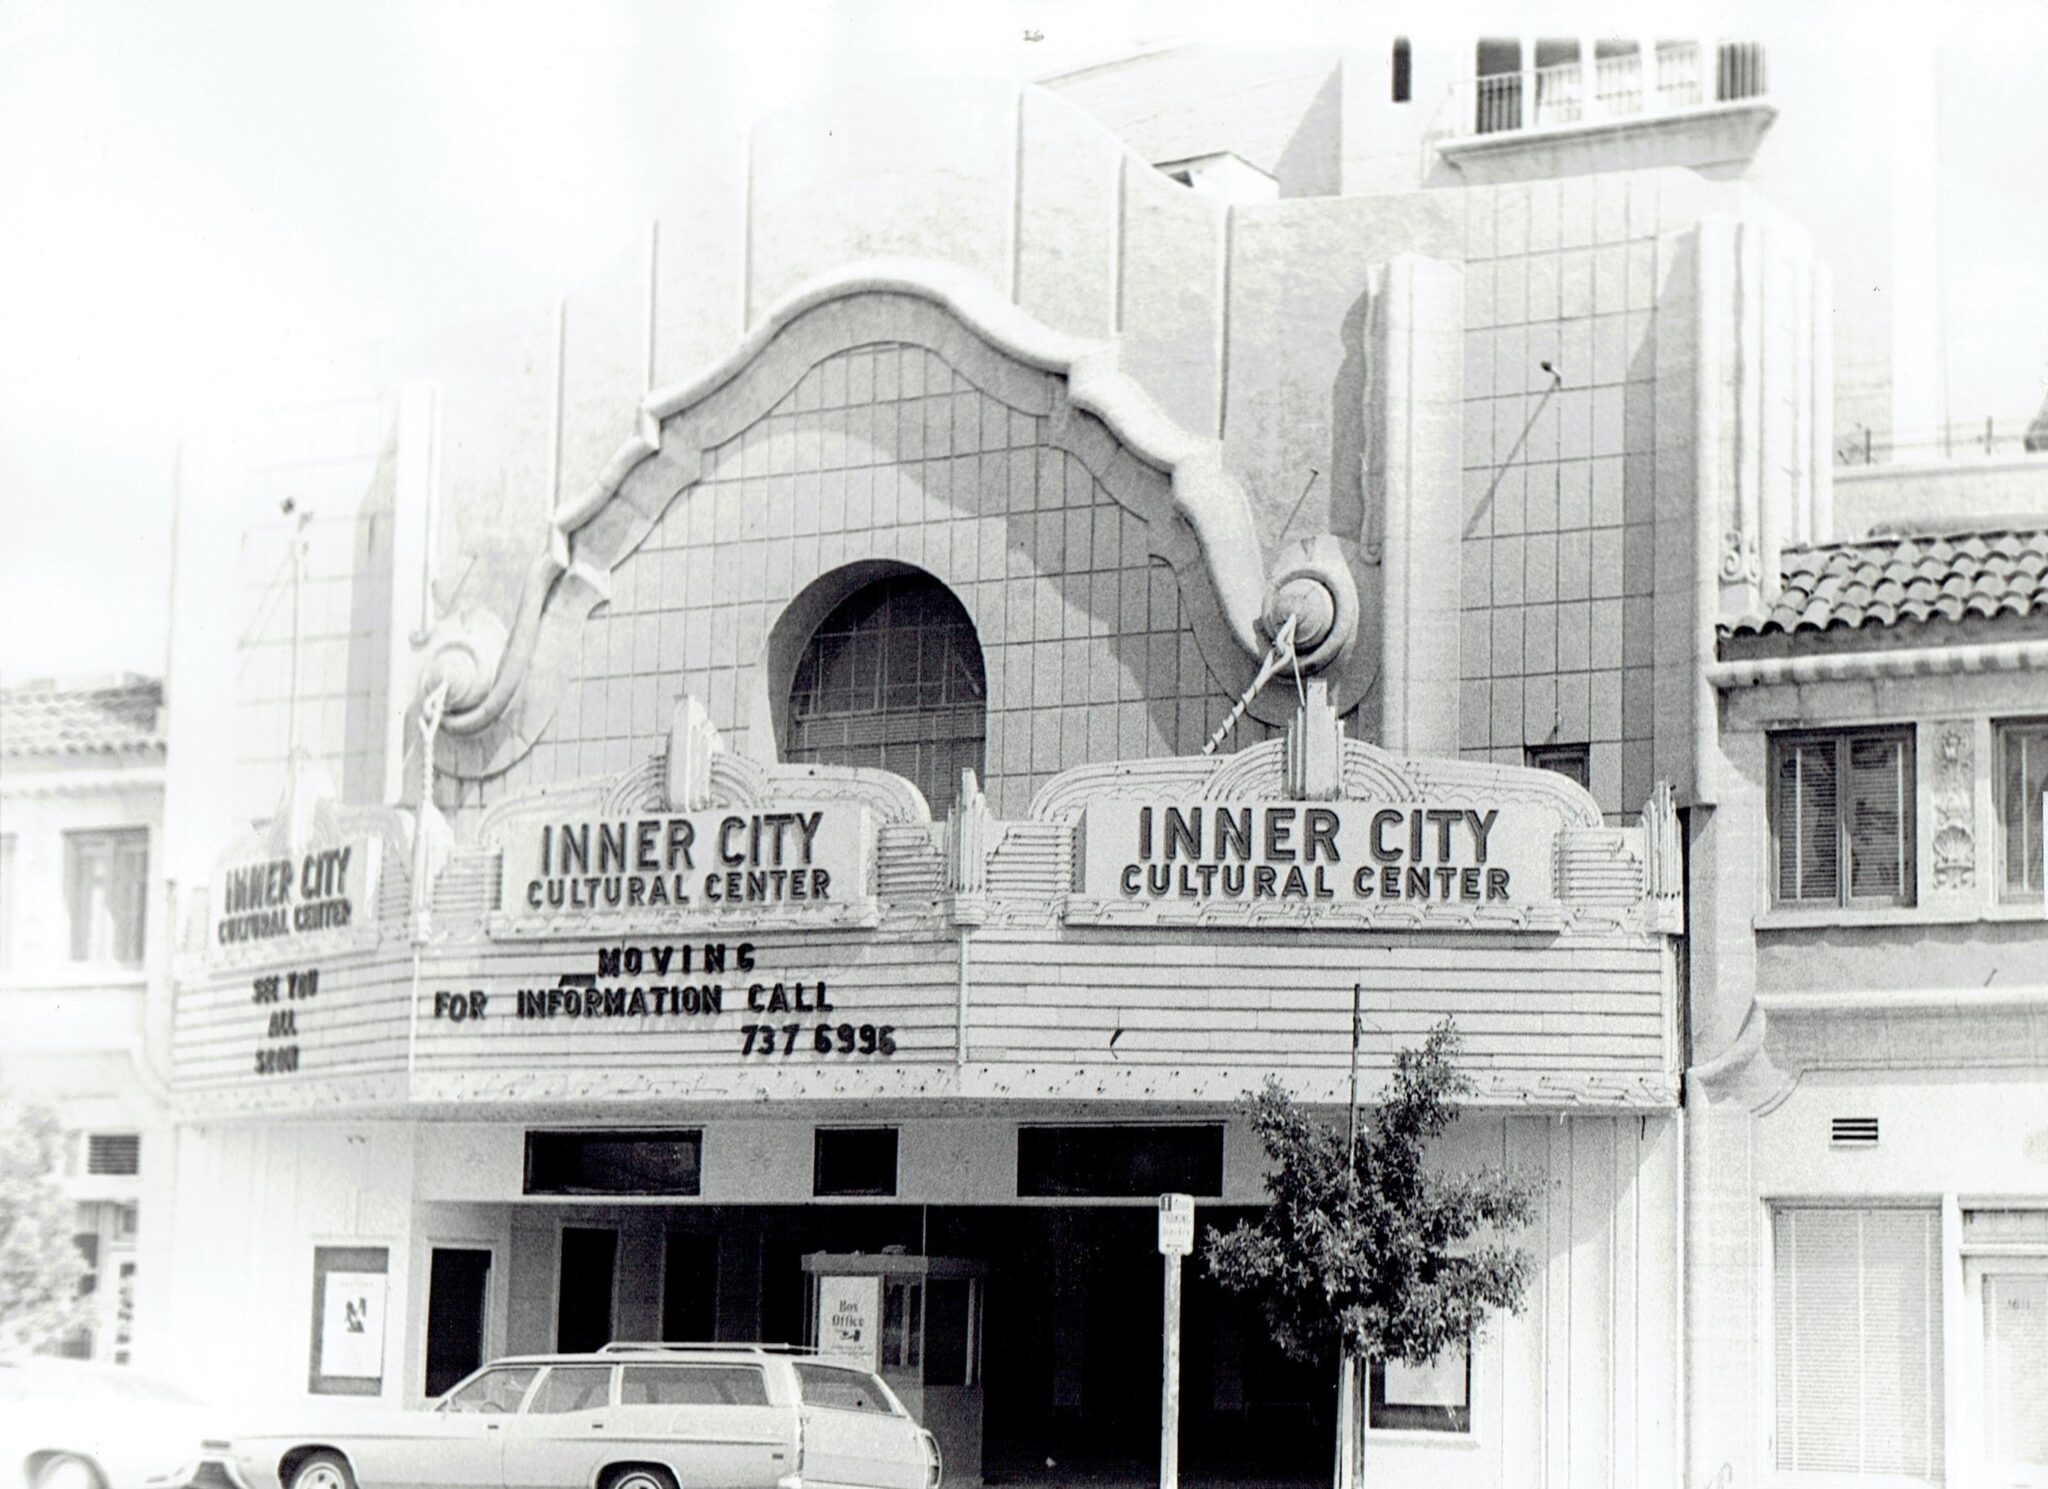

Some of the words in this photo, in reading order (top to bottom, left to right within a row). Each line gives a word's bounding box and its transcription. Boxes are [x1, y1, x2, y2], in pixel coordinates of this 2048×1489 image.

[540, 817, 696, 877] INNER
[718, 811, 825, 869] CITY
[1139, 806, 1341, 863] INNER
[1369, 807, 1500, 864] CITY
[225, 859, 293, 915] INNER
[300, 846, 352, 900] CITY
[526, 874, 690, 909] CULTURAL
[705, 868, 832, 901] CENTER
[1120, 864, 1335, 899] CULTURAL
[1353, 866, 1511, 901] CENTER
[217, 907, 290, 946] CULTURAL
[293, 898, 352, 933] CENTER
[598, 943, 756, 979] MOVING
[252, 973, 280, 1004] SEE
[287, 968, 319, 1000] YOU
[434, 989, 489, 1022] FOR
[516, 983, 722, 1020] INFORMATION
[747, 980, 835, 1014] CALL
[268, 1009, 298, 1038] ALL
[741, 1023, 800, 1056] 737
[814, 1022, 897, 1056] 6996
[832, 1314, 865, 1328] Office
[839, 1299, 858, 1313] Box
